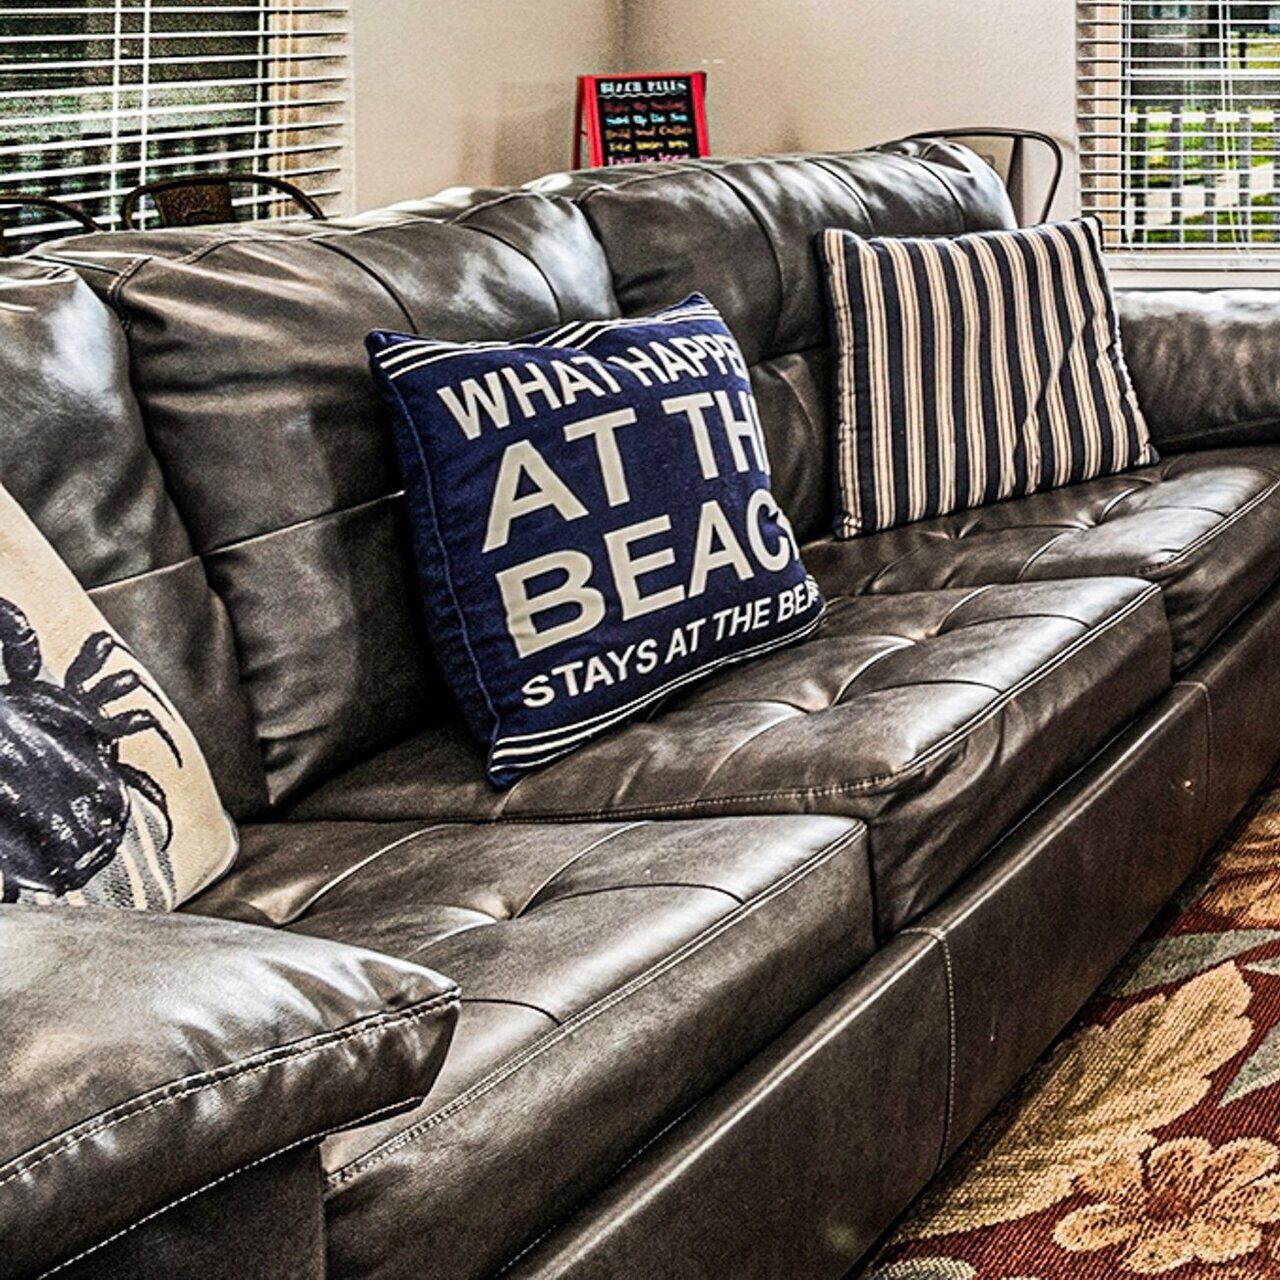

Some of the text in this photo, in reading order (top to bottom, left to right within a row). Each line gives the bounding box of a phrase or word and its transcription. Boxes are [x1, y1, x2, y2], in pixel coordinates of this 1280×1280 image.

[436, 333, 750, 441] WHAT HAPPE
[481, 407, 638, 554] AT
[494, 488, 801, 659] BEAC
[521, 574, 819, 709] STAYS AT THE BEA
